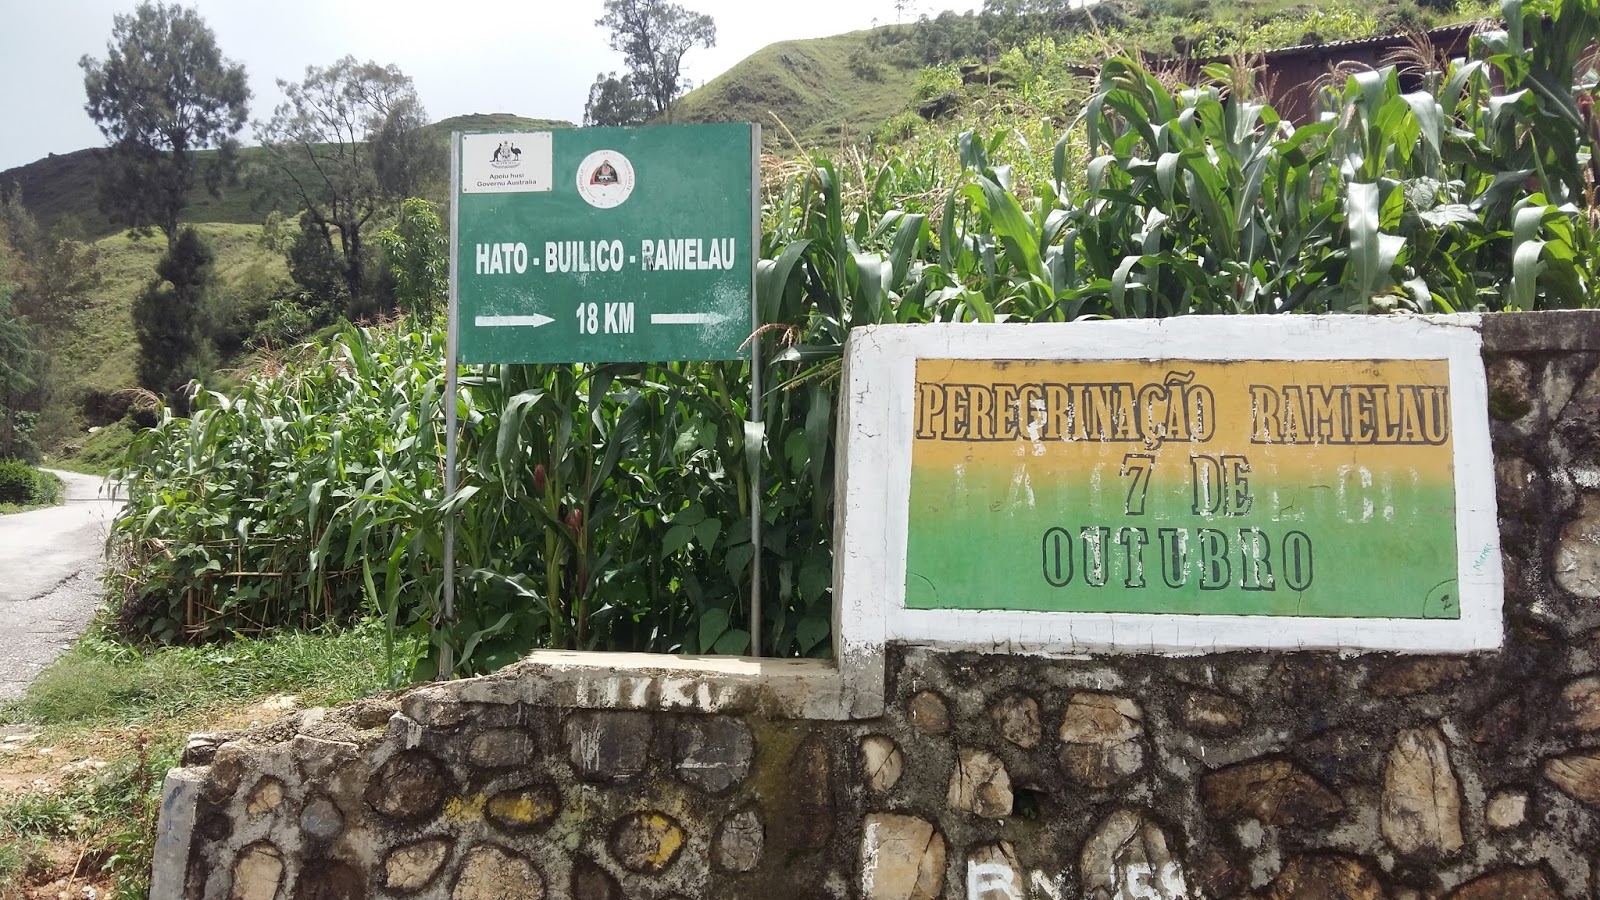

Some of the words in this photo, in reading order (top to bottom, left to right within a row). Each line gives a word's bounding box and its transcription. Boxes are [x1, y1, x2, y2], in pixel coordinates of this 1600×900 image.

[476, 242, 528, 274] HATO
[545, 239, 624, 273] BUILICO
[641, 237, 735, 271] RAMELAU
[576, 302, 599, 334] 18
[604, 301, 635, 334] KM
[916, 370, 1216, 451] PEREGRINAÇÃO
[1249, 384, 1449, 446] RAMELAU
[1119, 453, 1156, 516] 7
[1190, 454, 1252, 517] DE
[1042, 525, 1313, 591] OUTUBRO
